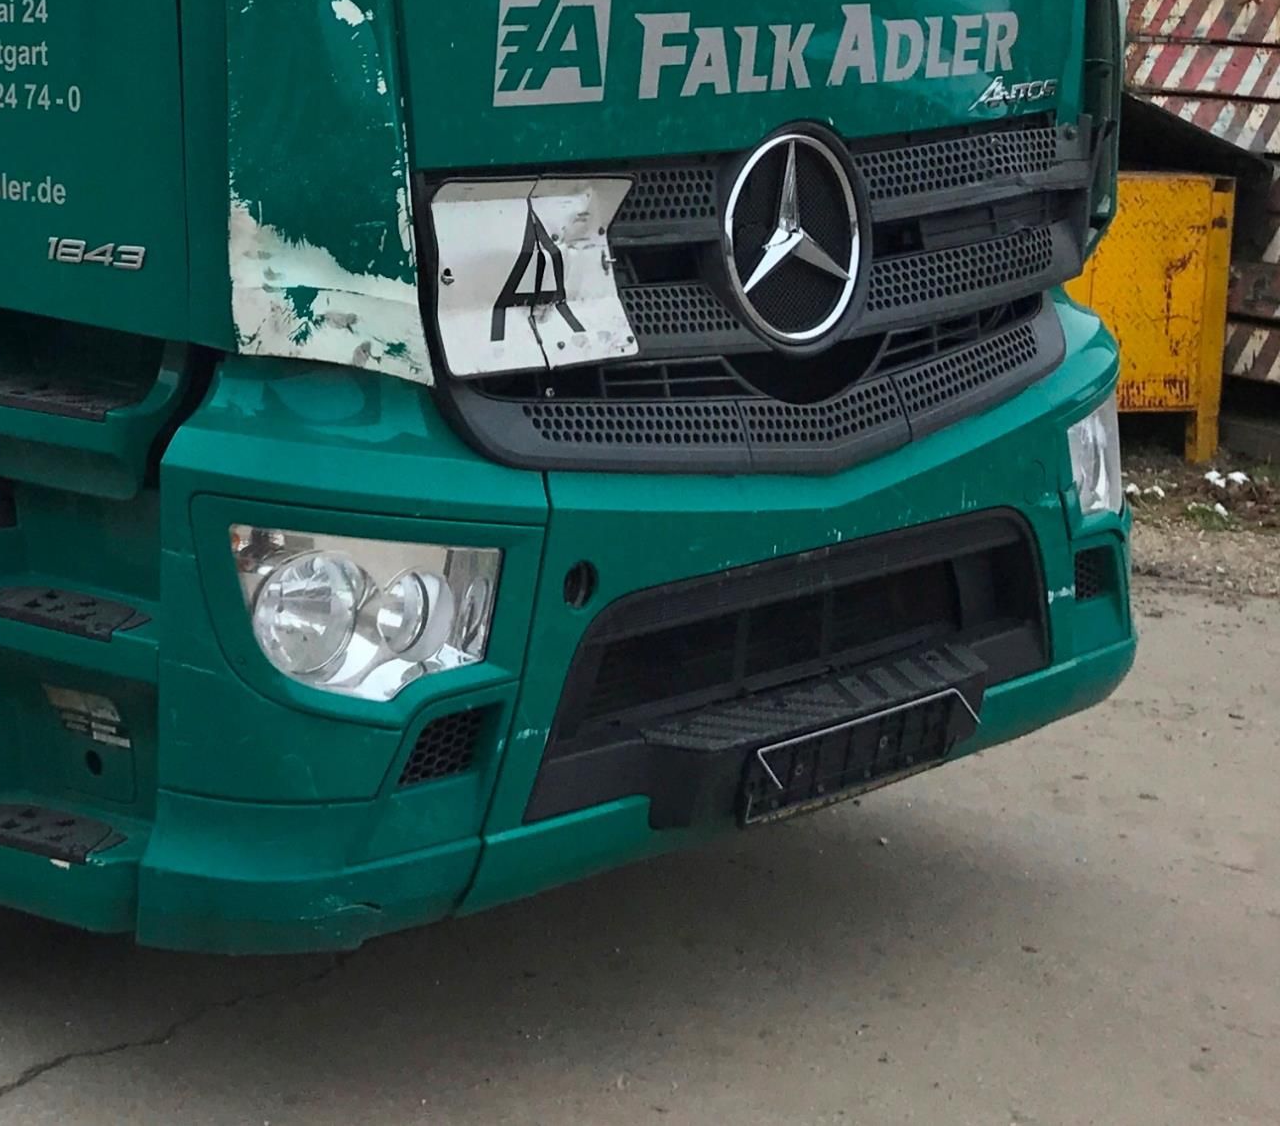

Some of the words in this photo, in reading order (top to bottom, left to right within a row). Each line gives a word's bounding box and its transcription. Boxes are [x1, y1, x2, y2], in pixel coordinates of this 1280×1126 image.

[634, 11, 815, 100] FALK
[825, 3, 1020, 87] ADLER
[47, 236, 146, 271] 1843
